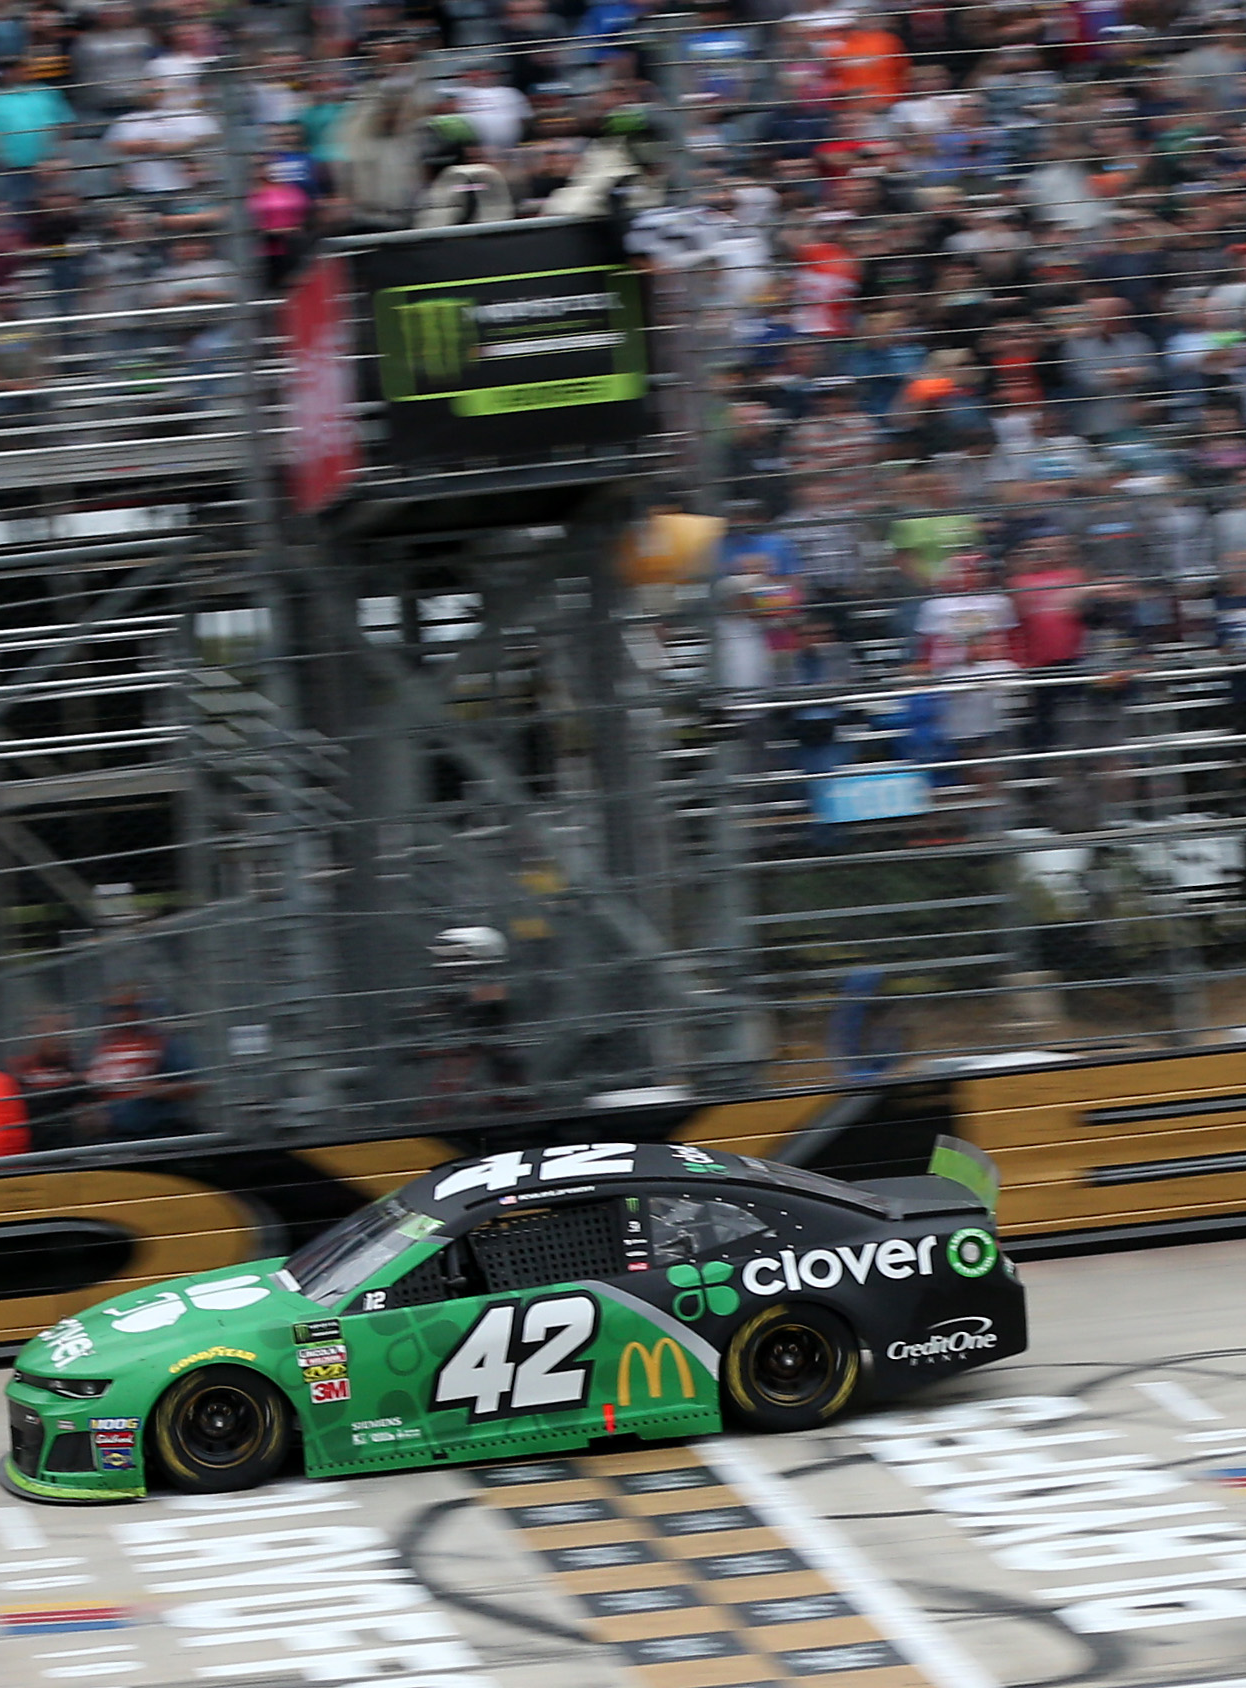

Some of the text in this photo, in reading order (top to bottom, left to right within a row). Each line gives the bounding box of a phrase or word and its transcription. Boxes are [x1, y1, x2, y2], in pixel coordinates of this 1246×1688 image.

[434, 1142, 637, 1201] 42
[741, 1234, 938, 1296] clover
[168, 1345, 257, 1374] GOODYEAR
[435, 1296, 596, 1414] 42
[314, 1380, 349, 1401] 3M
[90, 1418, 140, 1430] MOOG
